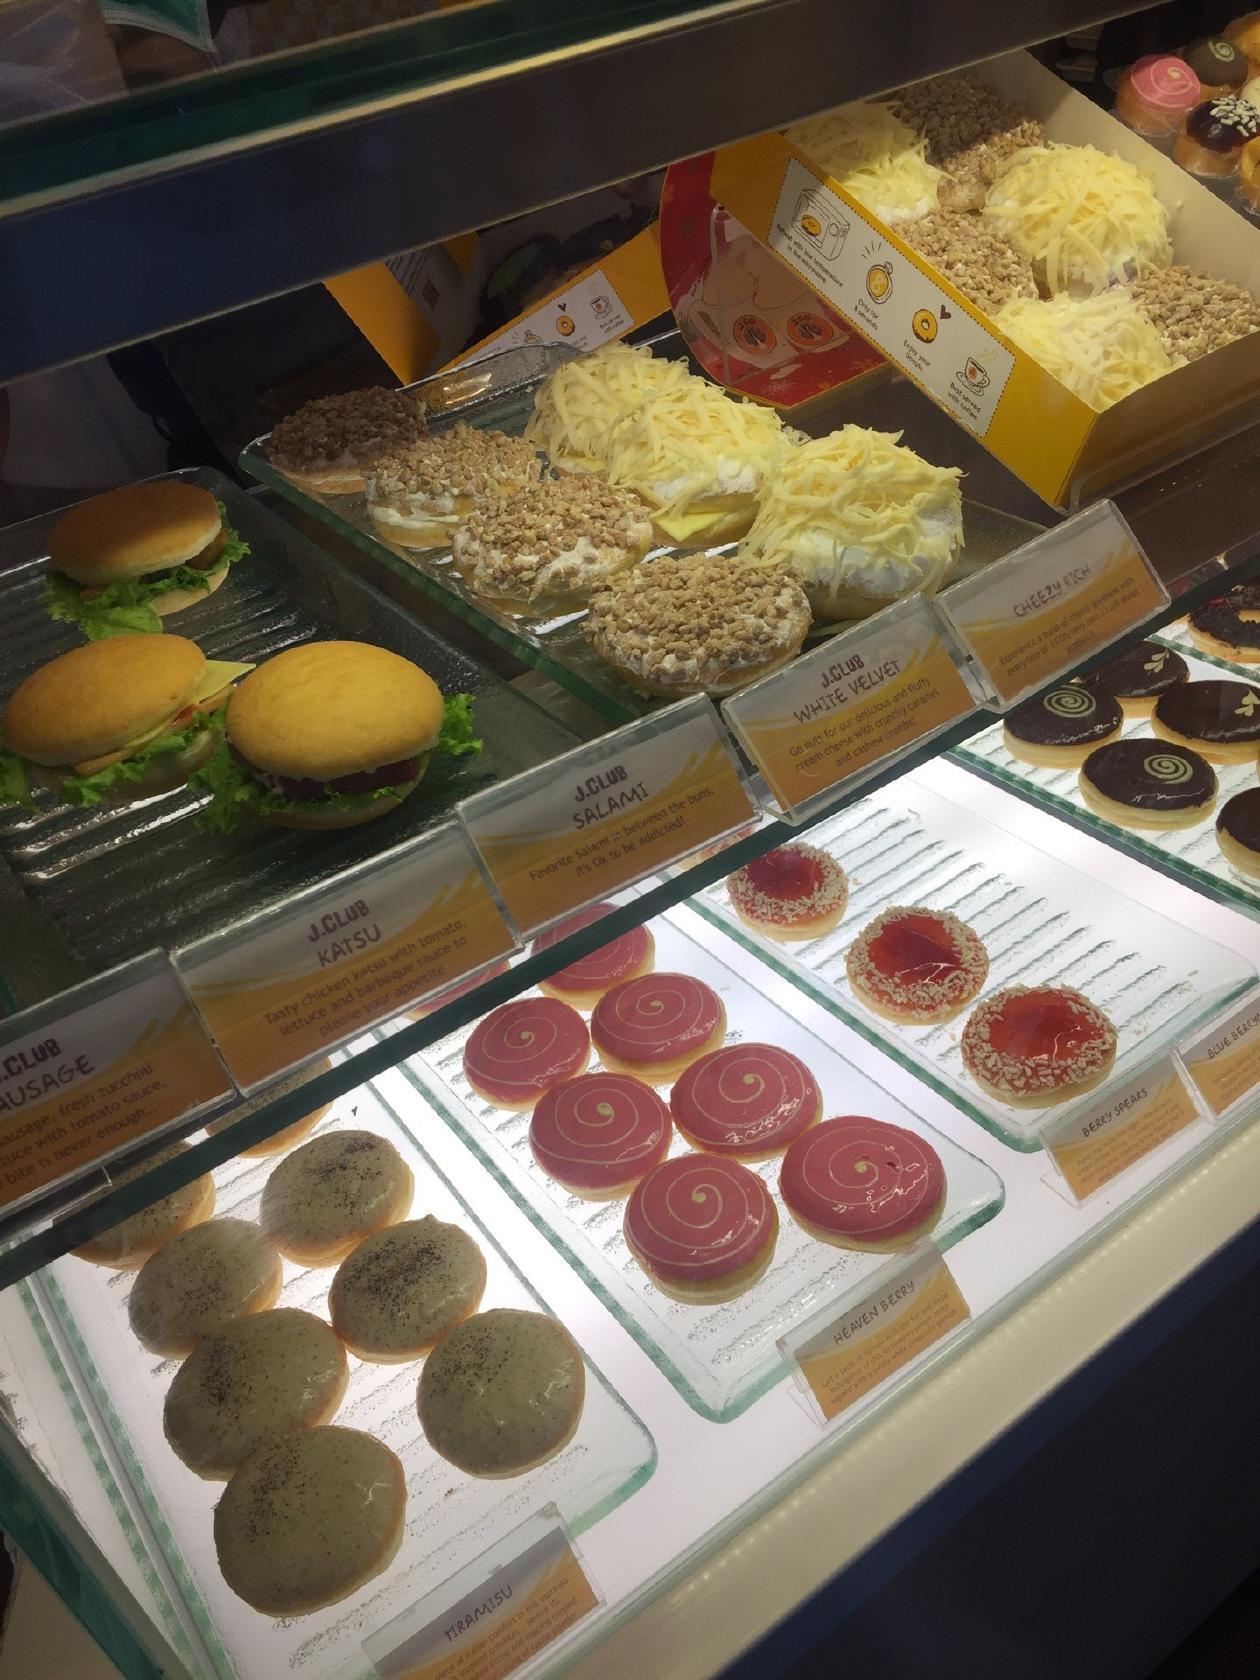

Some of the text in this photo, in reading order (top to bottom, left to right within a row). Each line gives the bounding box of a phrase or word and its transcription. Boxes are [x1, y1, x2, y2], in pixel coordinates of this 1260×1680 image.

[1012, 563, 1092, 618] CHEEZY RICH
[792, 659, 901, 725] WHITE VELVET
[821, 653, 865, 689] J.CLUB
[794, 751, 824, 772] cream
[853, 723, 874, 740] with
[823, 726, 838, 739] for
[574, 764, 628, 803] J.CLUB
[835, 751, 853, 768] and
[572, 780, 650, 830] SALAMI
[528, 855, 574, 881] Favorite
[574, 835, 610, 860] Salami
[622, 808, 669, 837] between
[668, 800, 687, 814] the
[307, 899, 371, 943] J.CLUB
[316, 922, 382, 968] KATSU
[263, 1002, 299, 1025] Tasty
[301, 976, 352, 1007] chicken
[351, 957, 388, 982] katsu
[388, 942, 418, 963] with
[278, 936, 468, 1037] lettuce and barbeque sauce to
[319, 1009, 364, 1037] please
[362, 992, 392, 1014] your
[0, 1038, 62, 1084] .CLUB
[1206, 1036, 1232, 1060] BLUE
[58, 1093, 96, 1118] fresh
[96, 1062, 154, 1098] zucchini
[1082, 1087, 1148, 1138] BERRY SPEARS
[34, 1126, 68, 1150] with
[68, 1101, 121, 1132] tomato
[3, 1164, 37, 1186] bite
[37, 1156, 52, 1169] is
[53, 1135, 92, 1161] never
[833, 1305, 880, 1346] HEAVEN
[879, 1280, 915, 1312] BERRY
[443, 1584, 513, 1642] TIRAMISU
